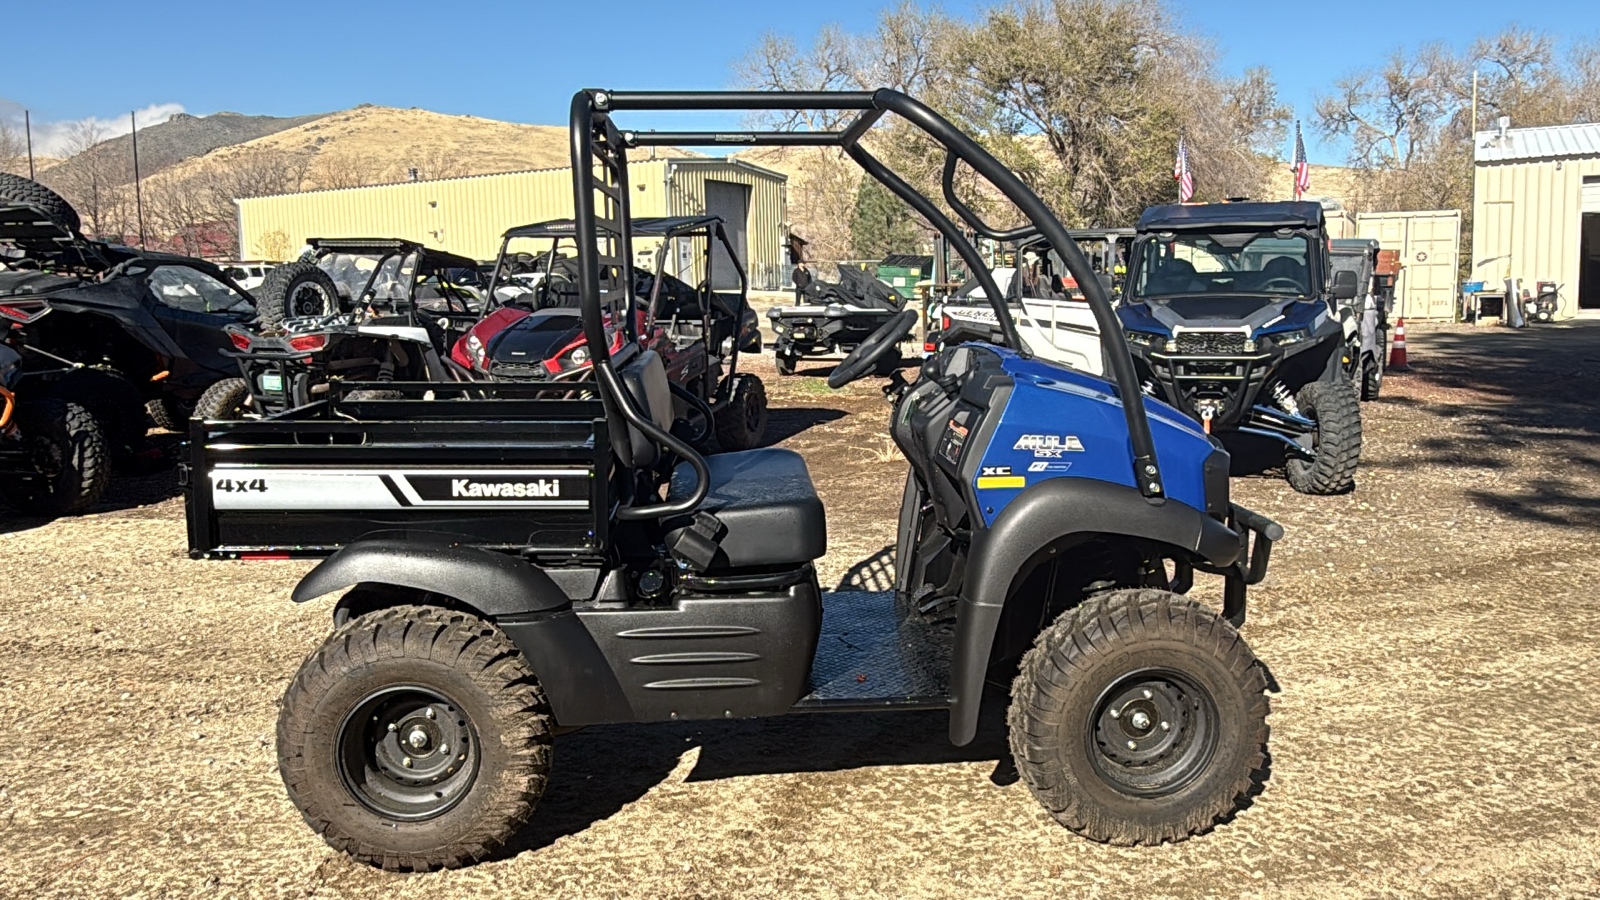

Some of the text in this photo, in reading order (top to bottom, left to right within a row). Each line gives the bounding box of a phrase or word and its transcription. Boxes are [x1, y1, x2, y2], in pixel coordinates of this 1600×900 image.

[1013, 434, 1086, 451] MULE
[1034, 450, 1063, 458] SX
[982, 466, 1011, 475] XC
[216, 477, 268, 493] 4x4
[451, 478, 560, 498] Kawasaki
